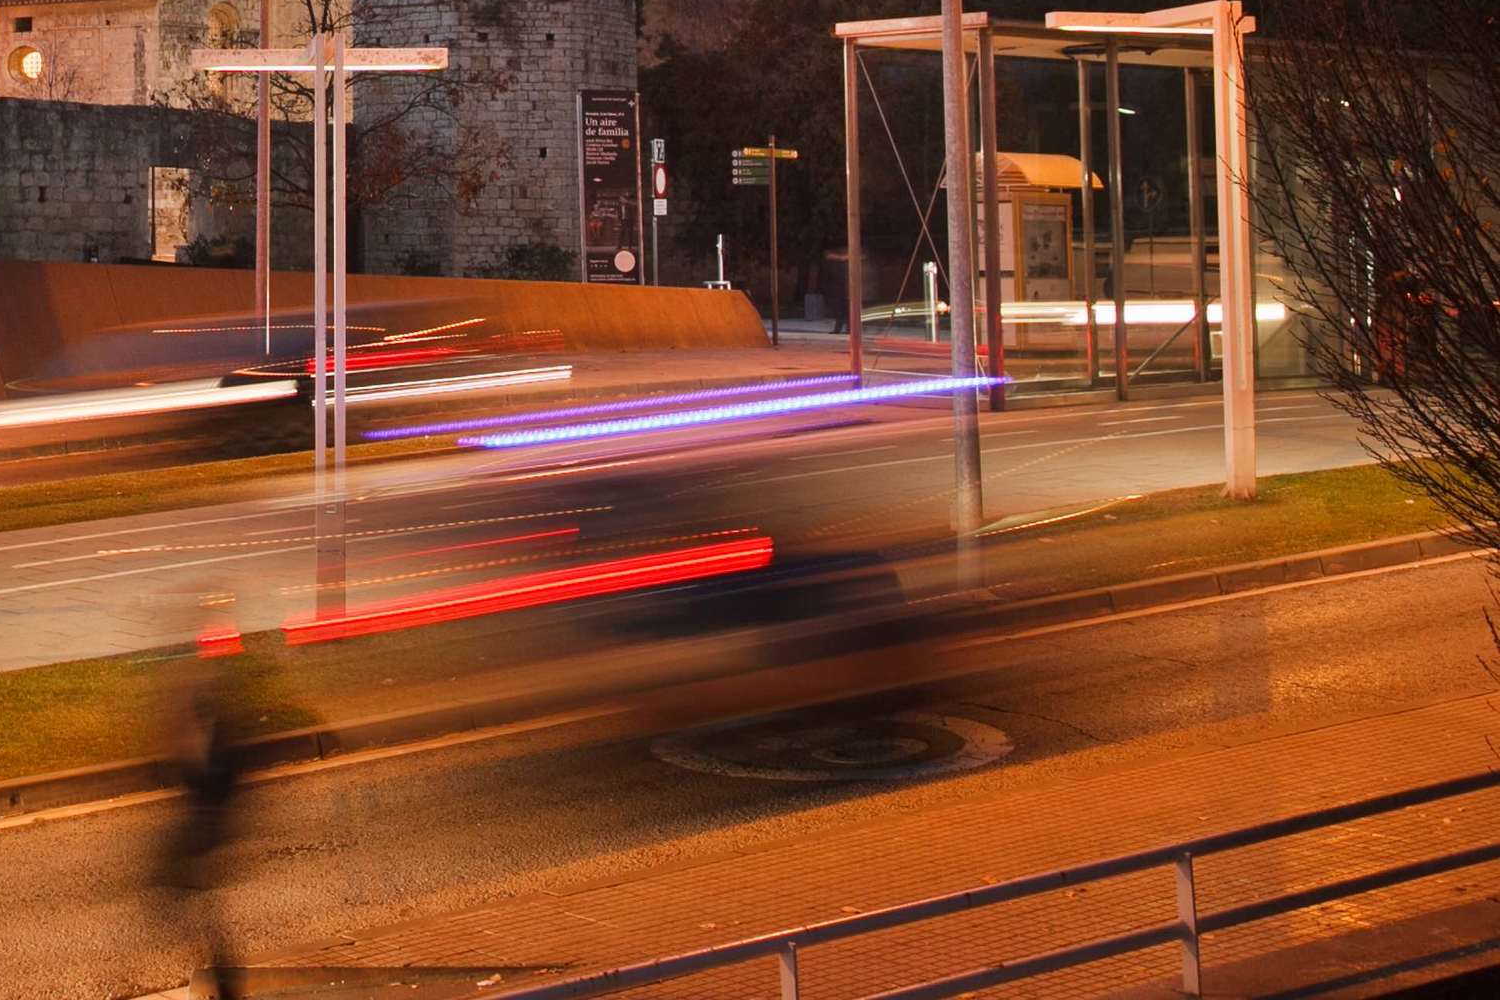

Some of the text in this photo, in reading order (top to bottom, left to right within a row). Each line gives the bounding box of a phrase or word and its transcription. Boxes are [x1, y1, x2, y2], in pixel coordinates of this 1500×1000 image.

[585, 117, 617, 126] Un aire
[585, 127, 597, 136] de
